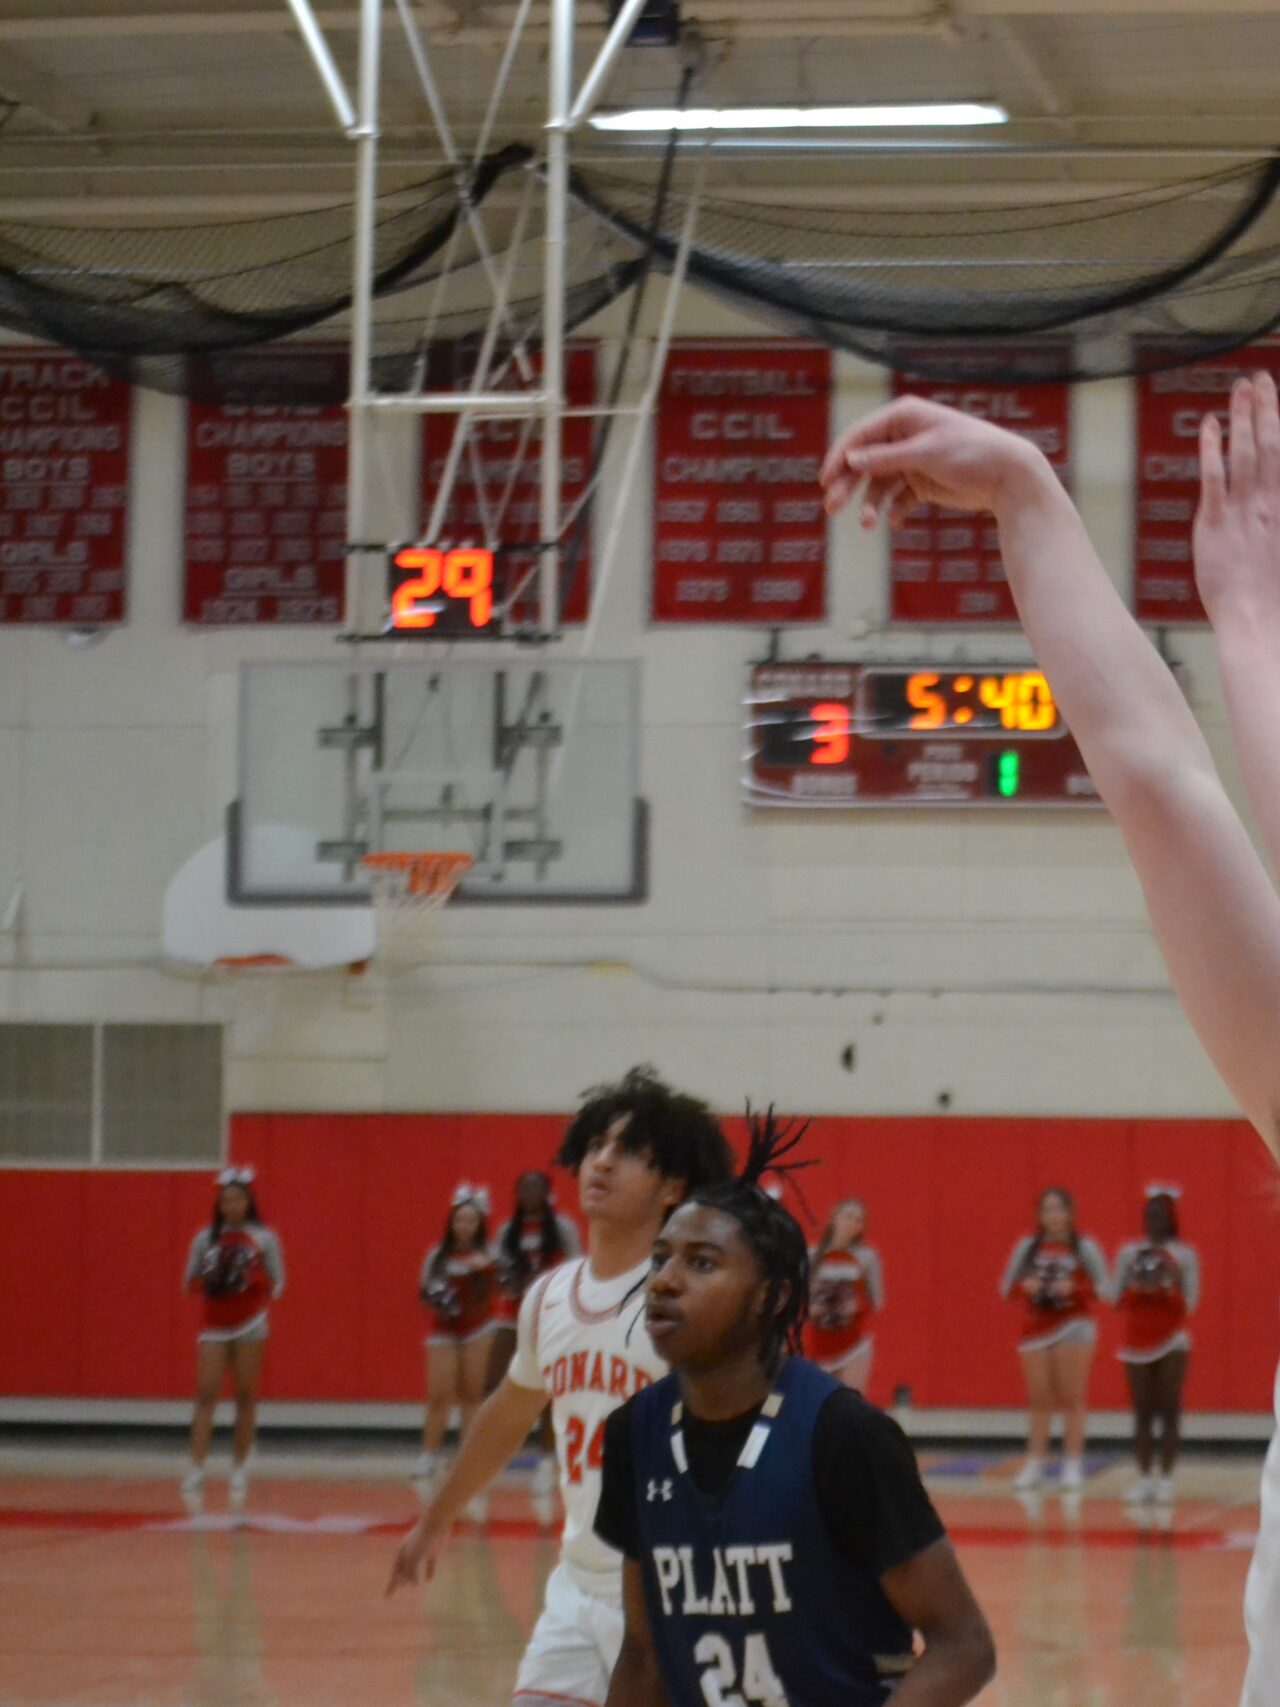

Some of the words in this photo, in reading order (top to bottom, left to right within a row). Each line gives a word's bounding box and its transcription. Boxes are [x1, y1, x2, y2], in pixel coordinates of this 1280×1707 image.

[0, 364, 109, 389] RACK
[670, 369, 816, 396] FOOTBALL
[690, 412, 794, 440] CCIL
[3, 456, 88, 480] BOYS
[227, 452, 315, 475] BOYS
[662, 456, 818, 483] CHAMPIONS
[391, 547, 494, 628] 29
[907, 671, 1055, 730] 5:40
[810, 703, 849, 764] 3
[999, 750, 1019, 796] 1
[543, 1349, 654, 1400] ONAR
[652, 1543, 793, 1616] PLATT
[694, 1632, 790, 1707] 24
